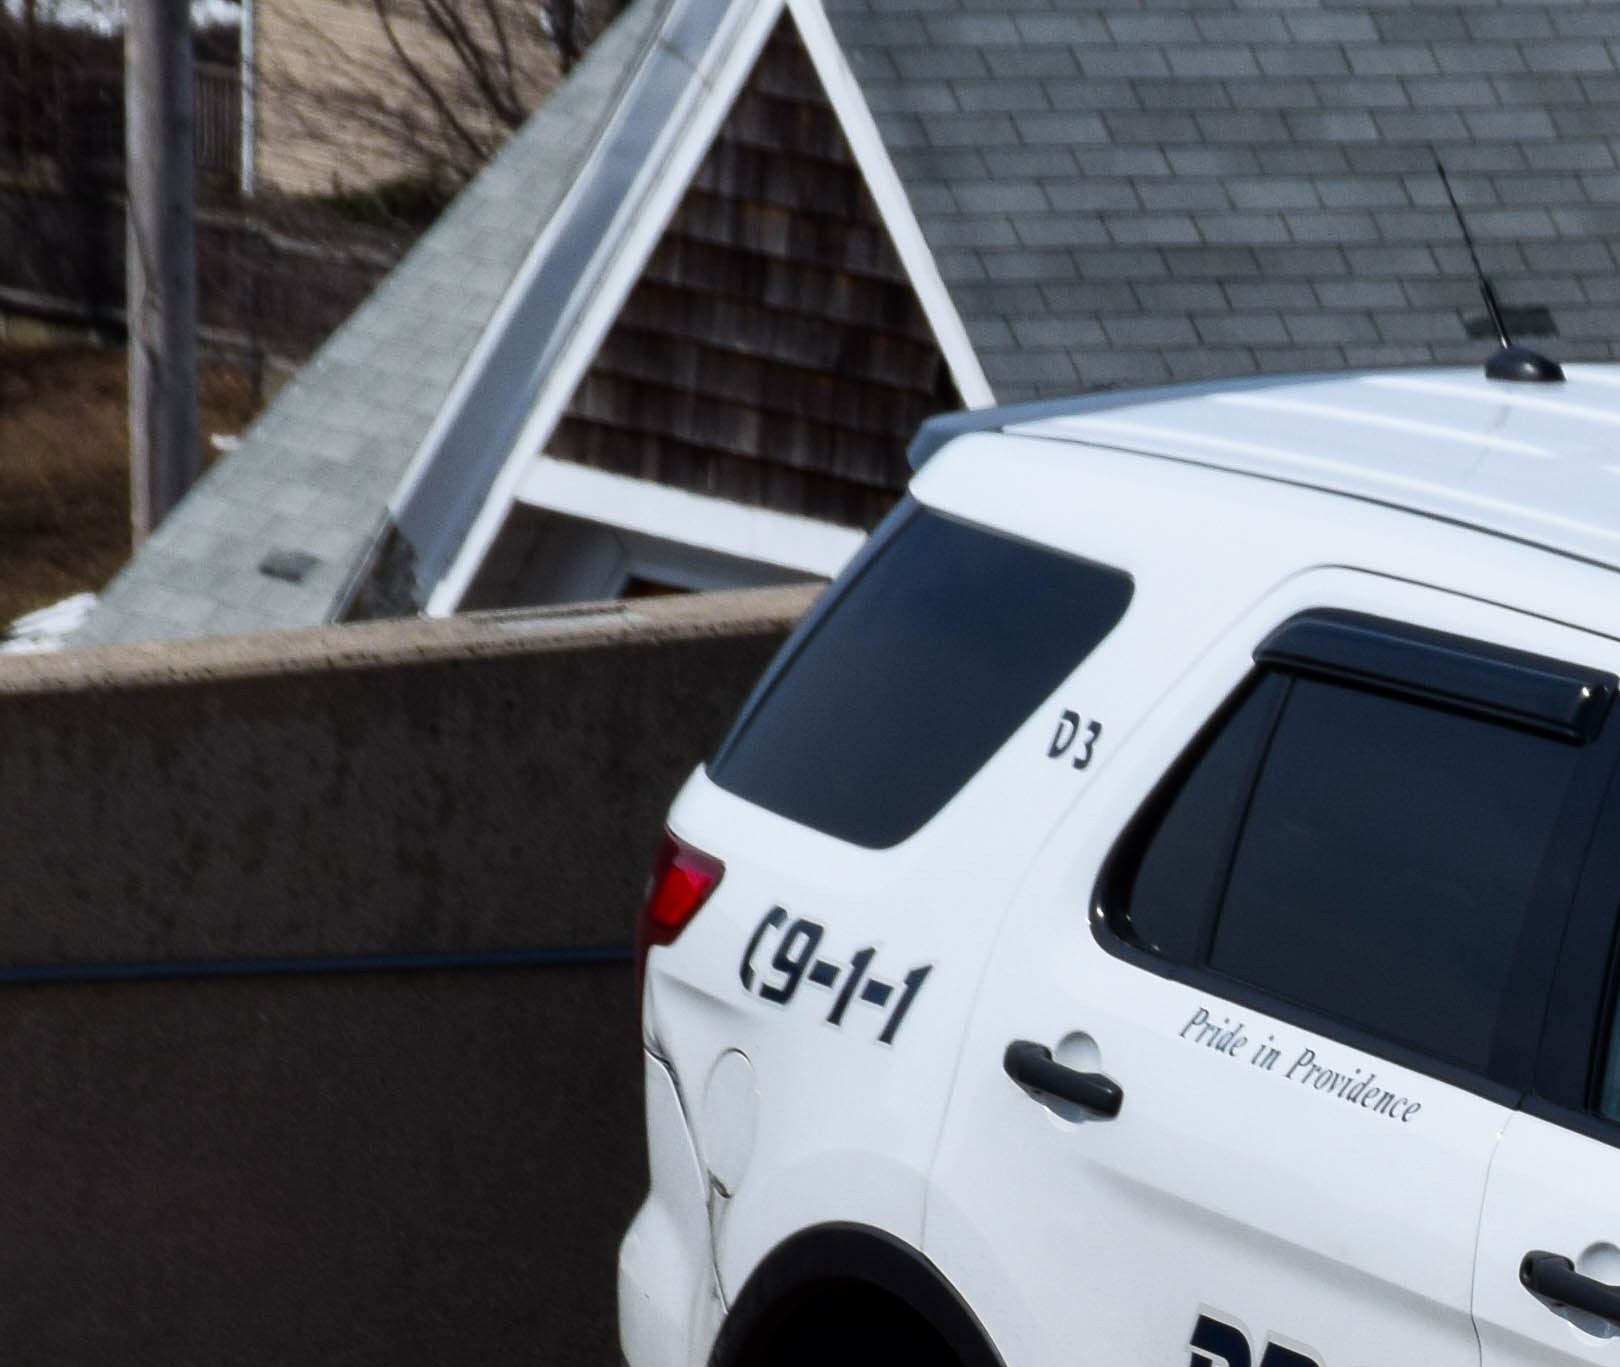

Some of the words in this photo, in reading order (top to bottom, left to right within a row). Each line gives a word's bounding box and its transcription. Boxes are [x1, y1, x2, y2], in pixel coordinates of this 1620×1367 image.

[1047, 709, 1102, 770] D3
[1179, 1006, 1249, 1057] Pride
[1250, 1034, 1282, 1071] in
[1285, 1047, 1422, 1122] Providence
